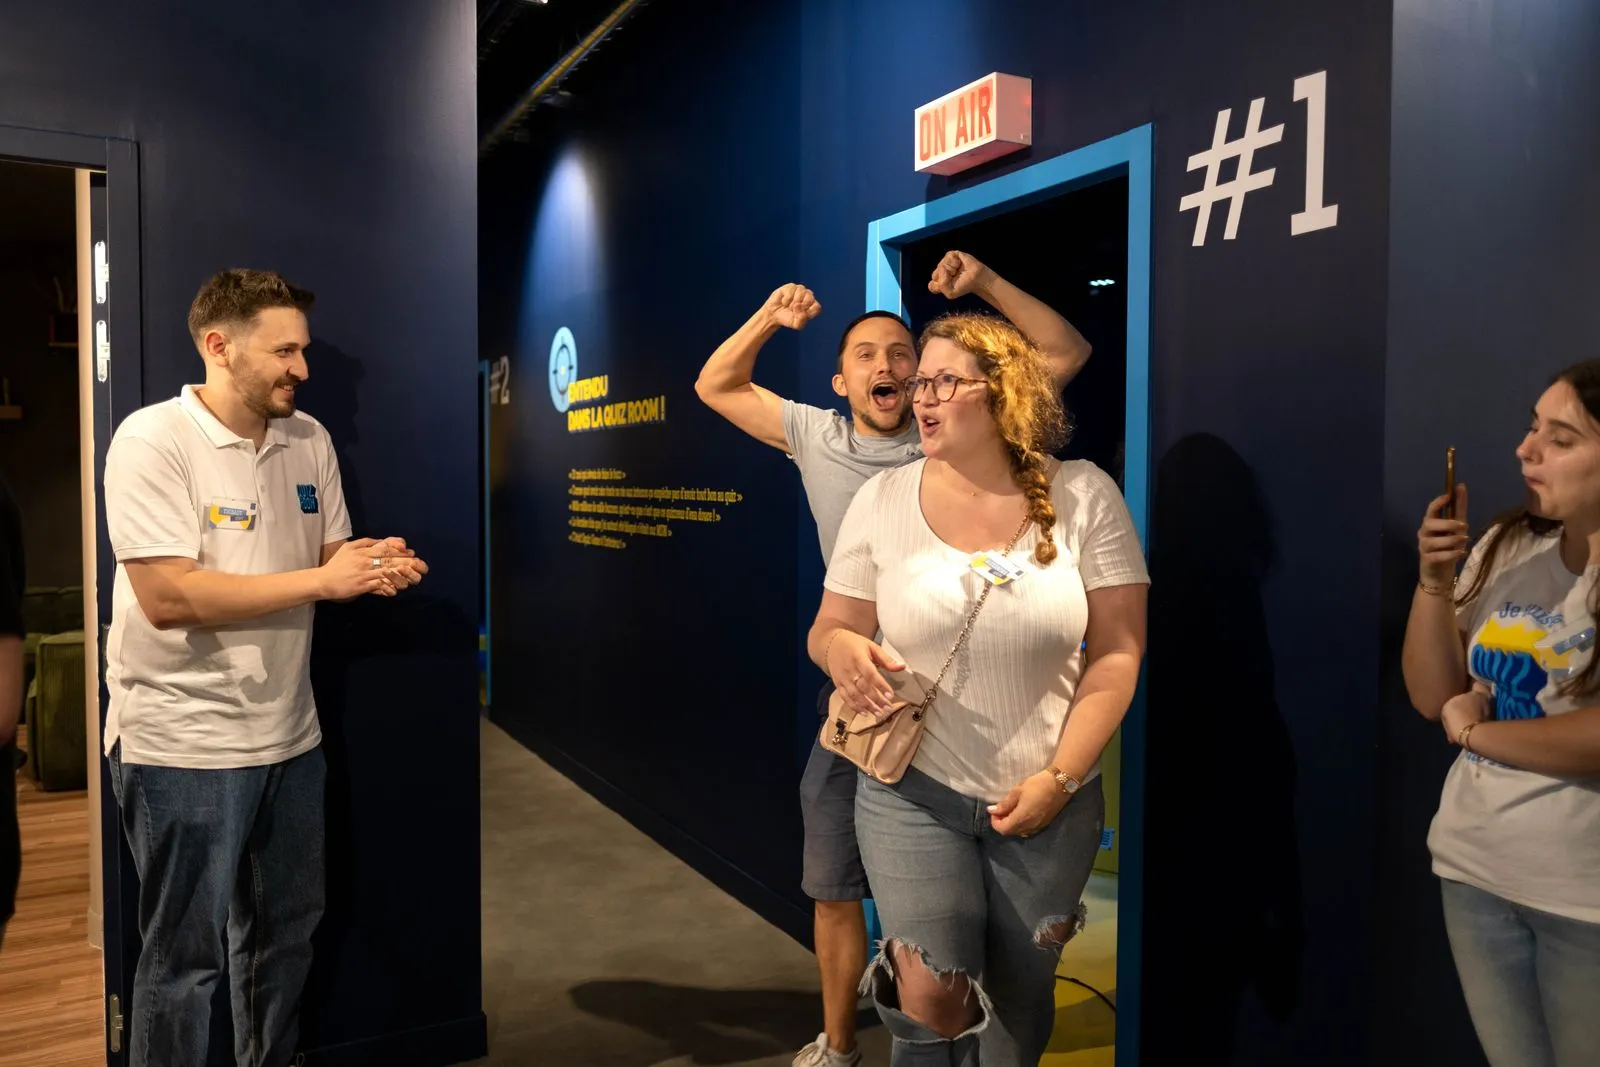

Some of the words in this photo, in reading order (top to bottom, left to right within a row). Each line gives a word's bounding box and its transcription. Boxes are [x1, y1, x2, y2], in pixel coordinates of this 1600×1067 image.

[920, 105, 946, 161] ON
[955, 86, 991, 148] AIR
[1179, 70, 1338, 246] #1
[490, 356, 510, 405] #2
[568, 374, 609, 403] ENTENDU
[567, 408, 591, 432] DANS
[591, 406, 604, 428] LA
[604, 402, 627, 426] QUIZ
[627, 397, 659, 424] ROOM
[1500, 602, 1520, 618] Je
